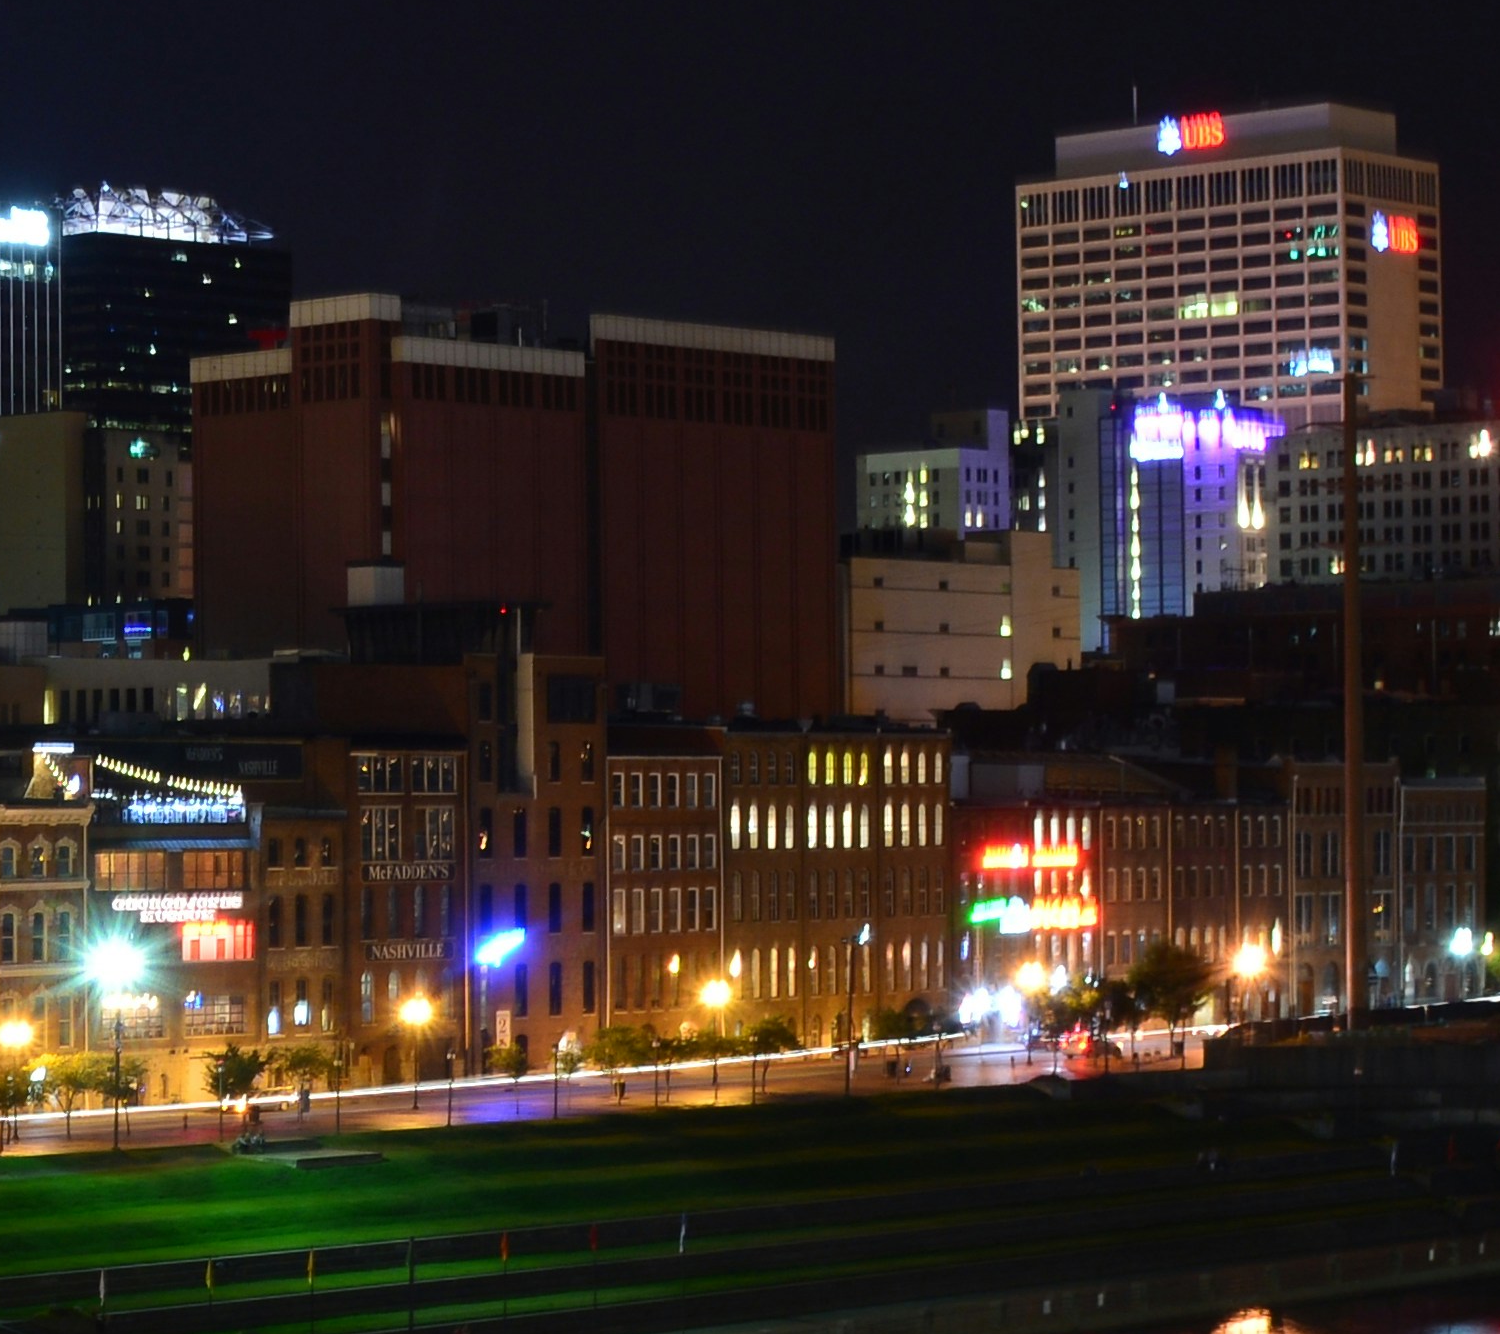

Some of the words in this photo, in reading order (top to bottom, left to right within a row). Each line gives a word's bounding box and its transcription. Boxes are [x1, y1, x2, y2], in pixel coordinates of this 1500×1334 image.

[1181, 114, 1224, 150] UBS
[1388, 218, 1419, 253] UBS
[369, 865, 449, 880] McFADDEN'S
[371, 944, 444, 960] NASHVILLE
